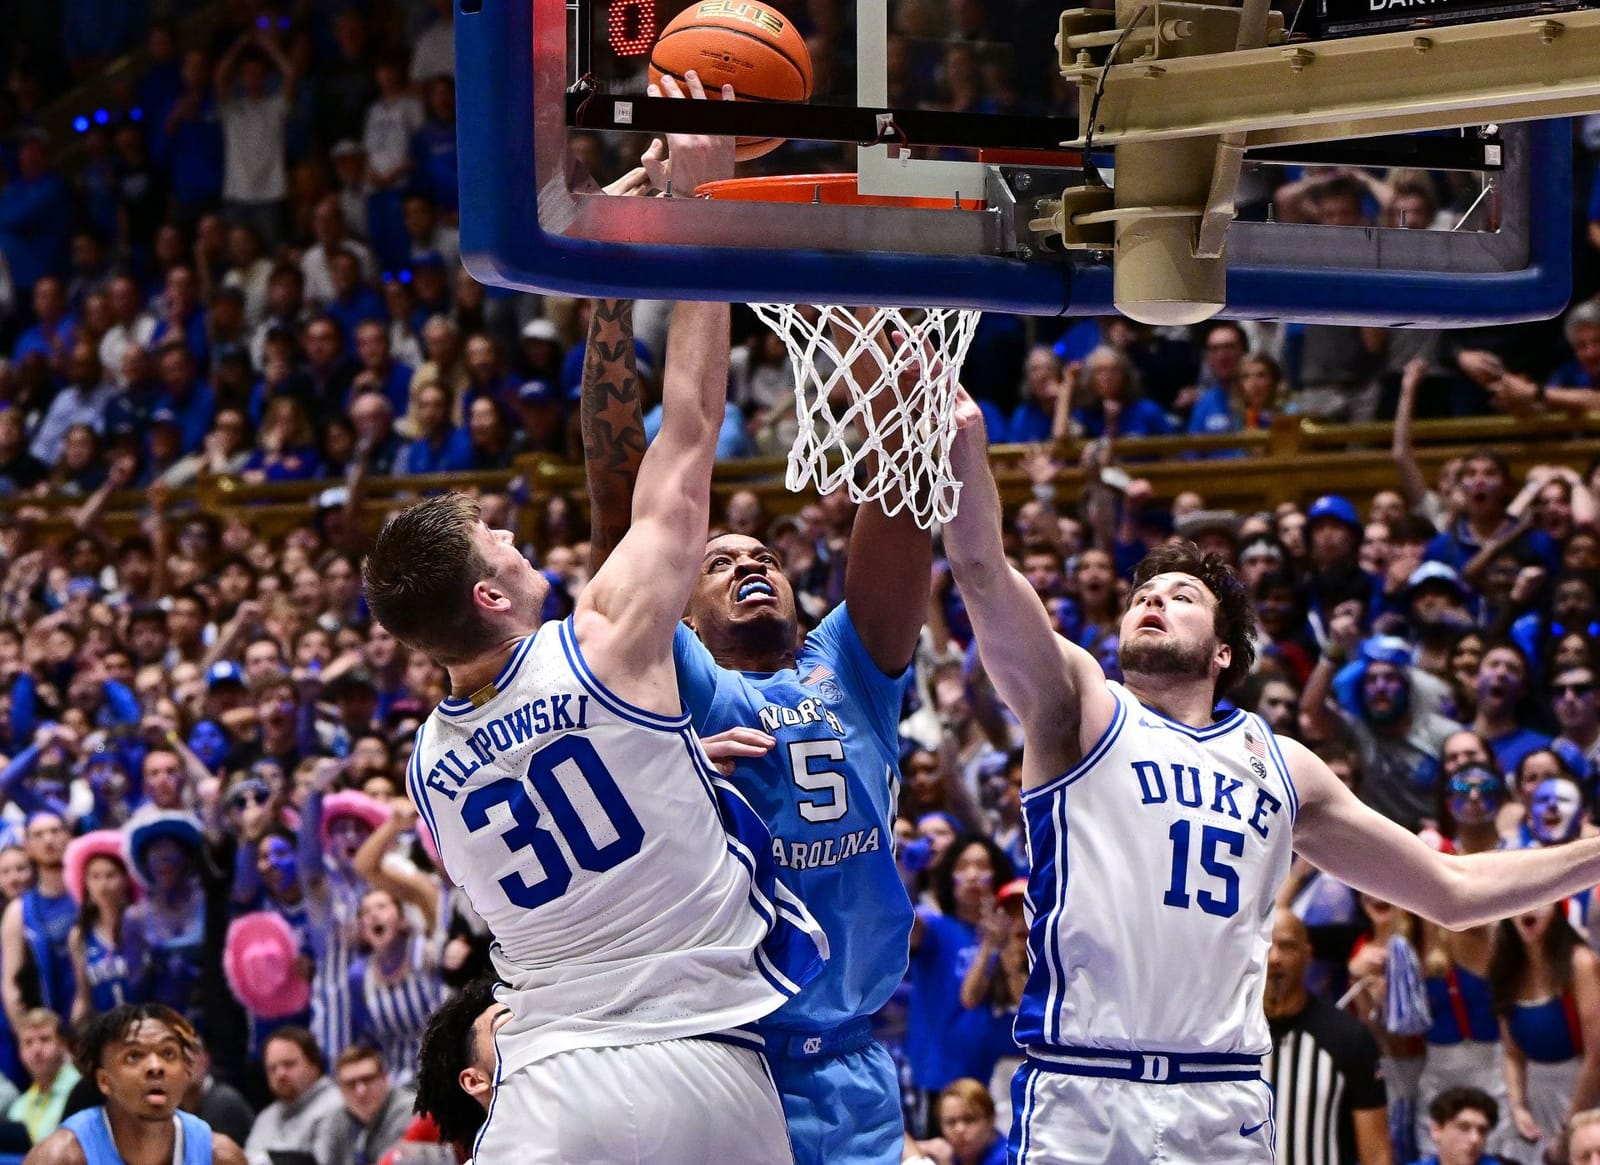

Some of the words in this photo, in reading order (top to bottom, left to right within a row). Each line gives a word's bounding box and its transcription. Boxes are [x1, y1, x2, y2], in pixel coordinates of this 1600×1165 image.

[697, 0, 784, 34] ELITE
[426, 693, 589, 801] FILIPOWSKI
[787, 738, 848, 823] 5
[460, 733, 646, 910] 30
[1130, 760, 1282, 839] DUKE
[771, 826, 880, 871] AROLINA
[1163, 819, 1245, 918] 15
